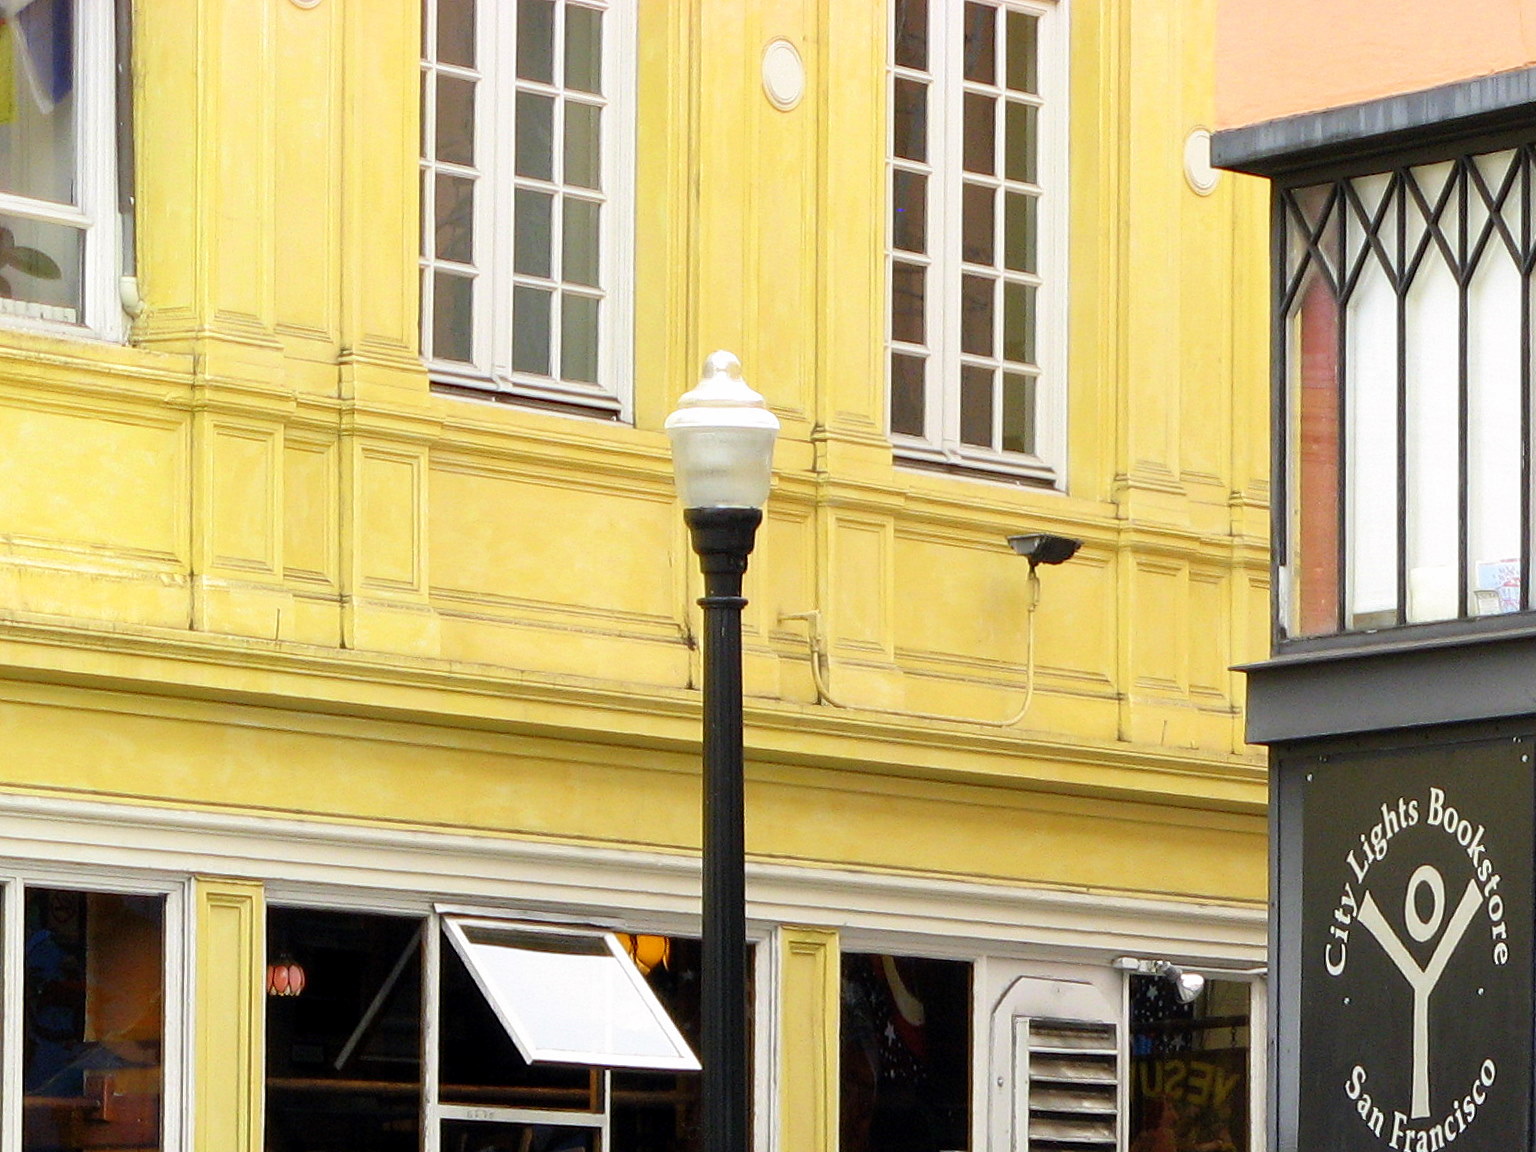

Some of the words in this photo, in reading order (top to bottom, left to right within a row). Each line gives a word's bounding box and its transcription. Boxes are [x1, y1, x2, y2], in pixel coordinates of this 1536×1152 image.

[1325, 881, 1358, 977] City
[1345, 796, 1418, 885] Lights
[1427, 787, 1509, 966] Bookstore
[1345, 1064, 1384, 1138] San
